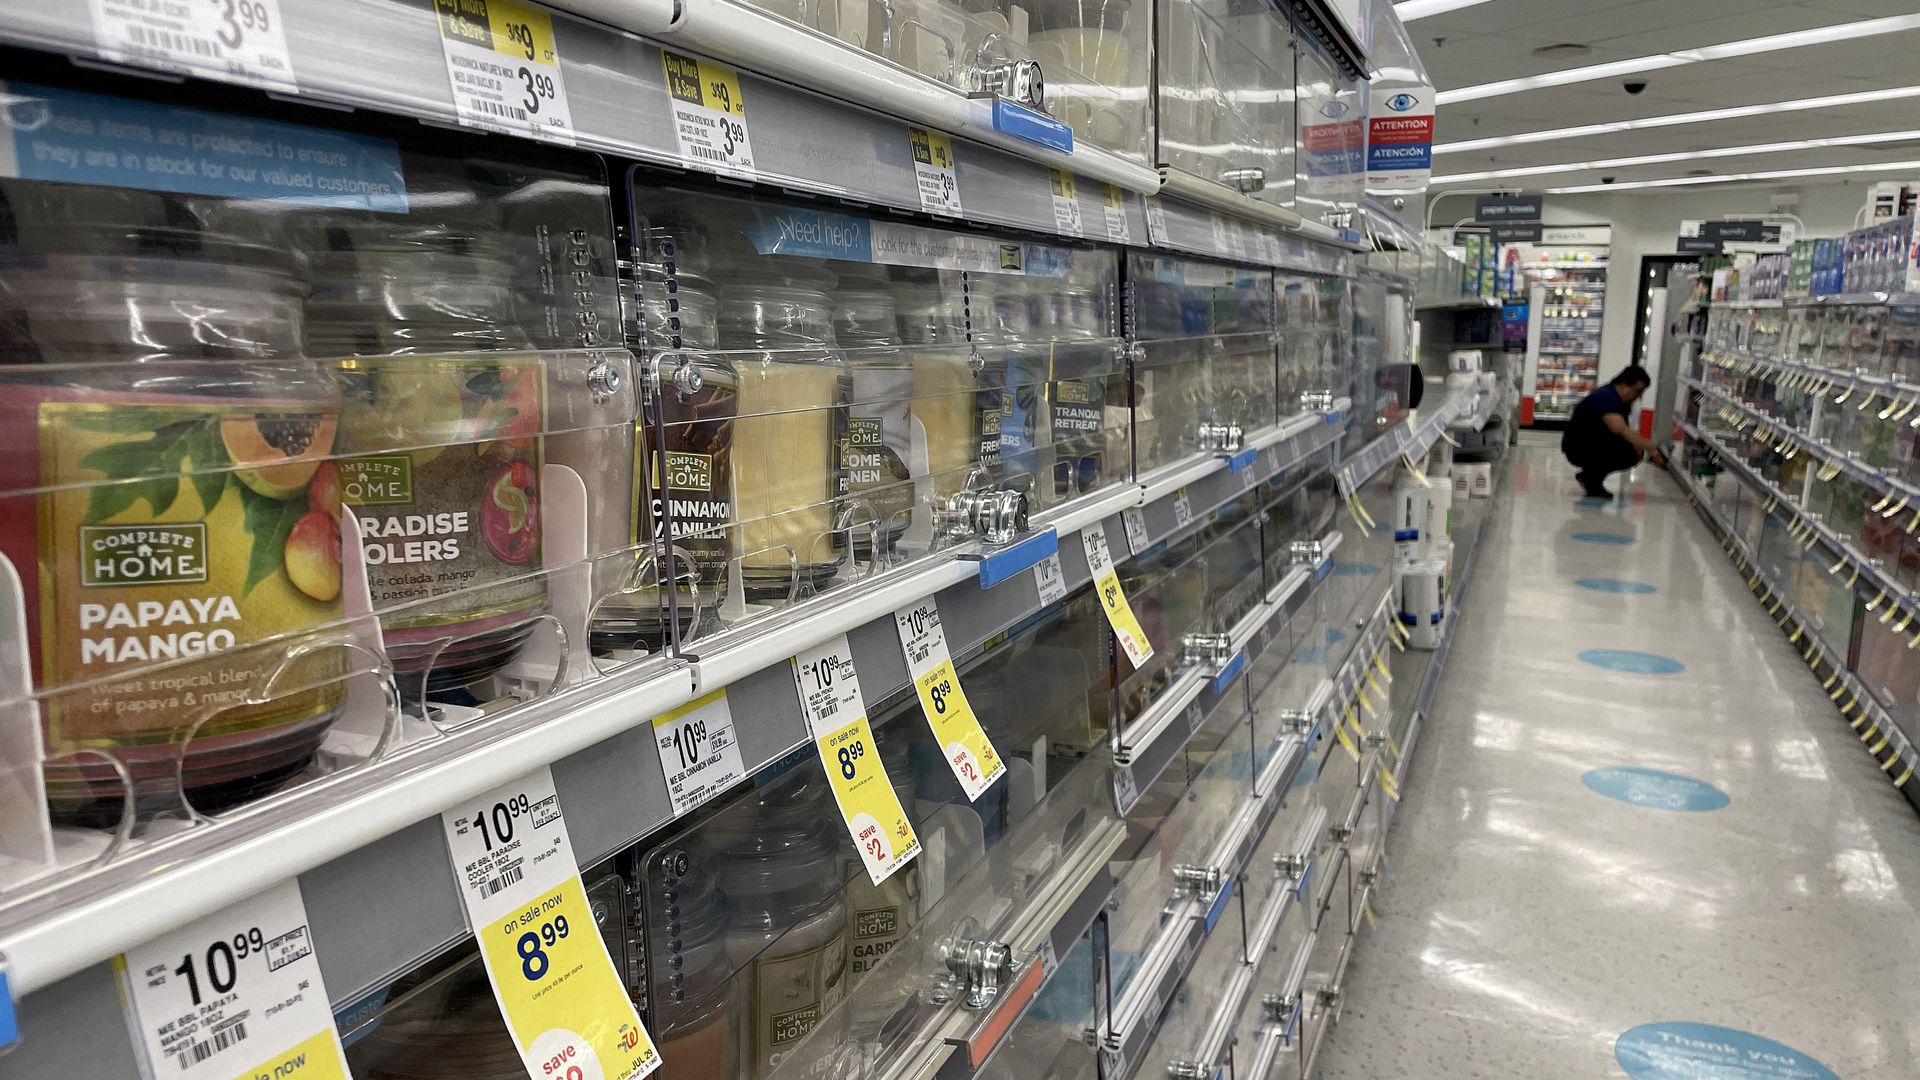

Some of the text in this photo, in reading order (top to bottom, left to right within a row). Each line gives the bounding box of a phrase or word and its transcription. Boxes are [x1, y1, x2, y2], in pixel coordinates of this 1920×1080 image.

[460, 16, 485, 41] Save
[666, 55, 698, 79] Buy More
[681, 79, 698, 100] Save
[1373, 120, 1428, 130] ATTENTION
[159, 128, 187, 146] are
[191, 132, 272, 158] protected
[278, 142, 293, 161] to
[297, 147, 348, 167] ensure
[32, 140, 79, 170] they
[85, 150, 117, 168] are
[123, 148, 141, 170] in
[145, 154, 196, 176] stock
[200, 157, 224, 179] for
[229, 166, 256, 183] our
[261, 165, 313, 189] valued
[778, 215, 859, 248] Need help?
[876, 235, 896, 251] Look
[910, 238, 922, 253] the
[1055, 418, 1097, 430] RETREAT
[1056, 407, 1100, 420] TRANQUIL
[852, 433, 879, 443] OME
[341, 463, 400, 477] MPLETE
[849, 453, 880, 468] OME
[851, 469, 880, 483] NEN
[346, 482, 402, 498] OME
[652, 499, 730, 519] CINNAMON
[360, 511, 469, 539] RADISE
[92, 531, 195, 551] COMPLETE
[364, 538, 460, 565] OLERS
[94, 555, 195, 578] HOME
[438, 569, 476, 586] mango
[80, 596, 242, 630] PAPAYA
[81, 628, 235, 665] MANGO
[151, 672, 214, 691] tropical
[115, 697, 178, 716] papaya
[184, 692, 197, 706] &
[830, 726, 860, 748] on sale now
[953, 751, 967, 766] save
[686, 761, 707, 778] CINNAMON
[960, 762, 978, 782] $2
[859, 825, 876, 841] save
[478, 857, 490, 867] BBL
[491, 840, 522, 860] PARADISE
[867, 838, 886, 861] $2
[468, 862, 494, 881] COOLER
[504, 893, 563, 935] on sale now
[860, 921, 895, 936] HOME
[200, 993, 239, 1017] PAPAYA
[776, 1009, 816, 1028] COMPLETE
[160, 1025, 198, 1047] MANGO
[274, 1053, 306, 1079] now
[543, 1045, 576, 1075] save
[632, 1056, 645, 1071] JUL
[644, 1048, 653, 1060] 29
